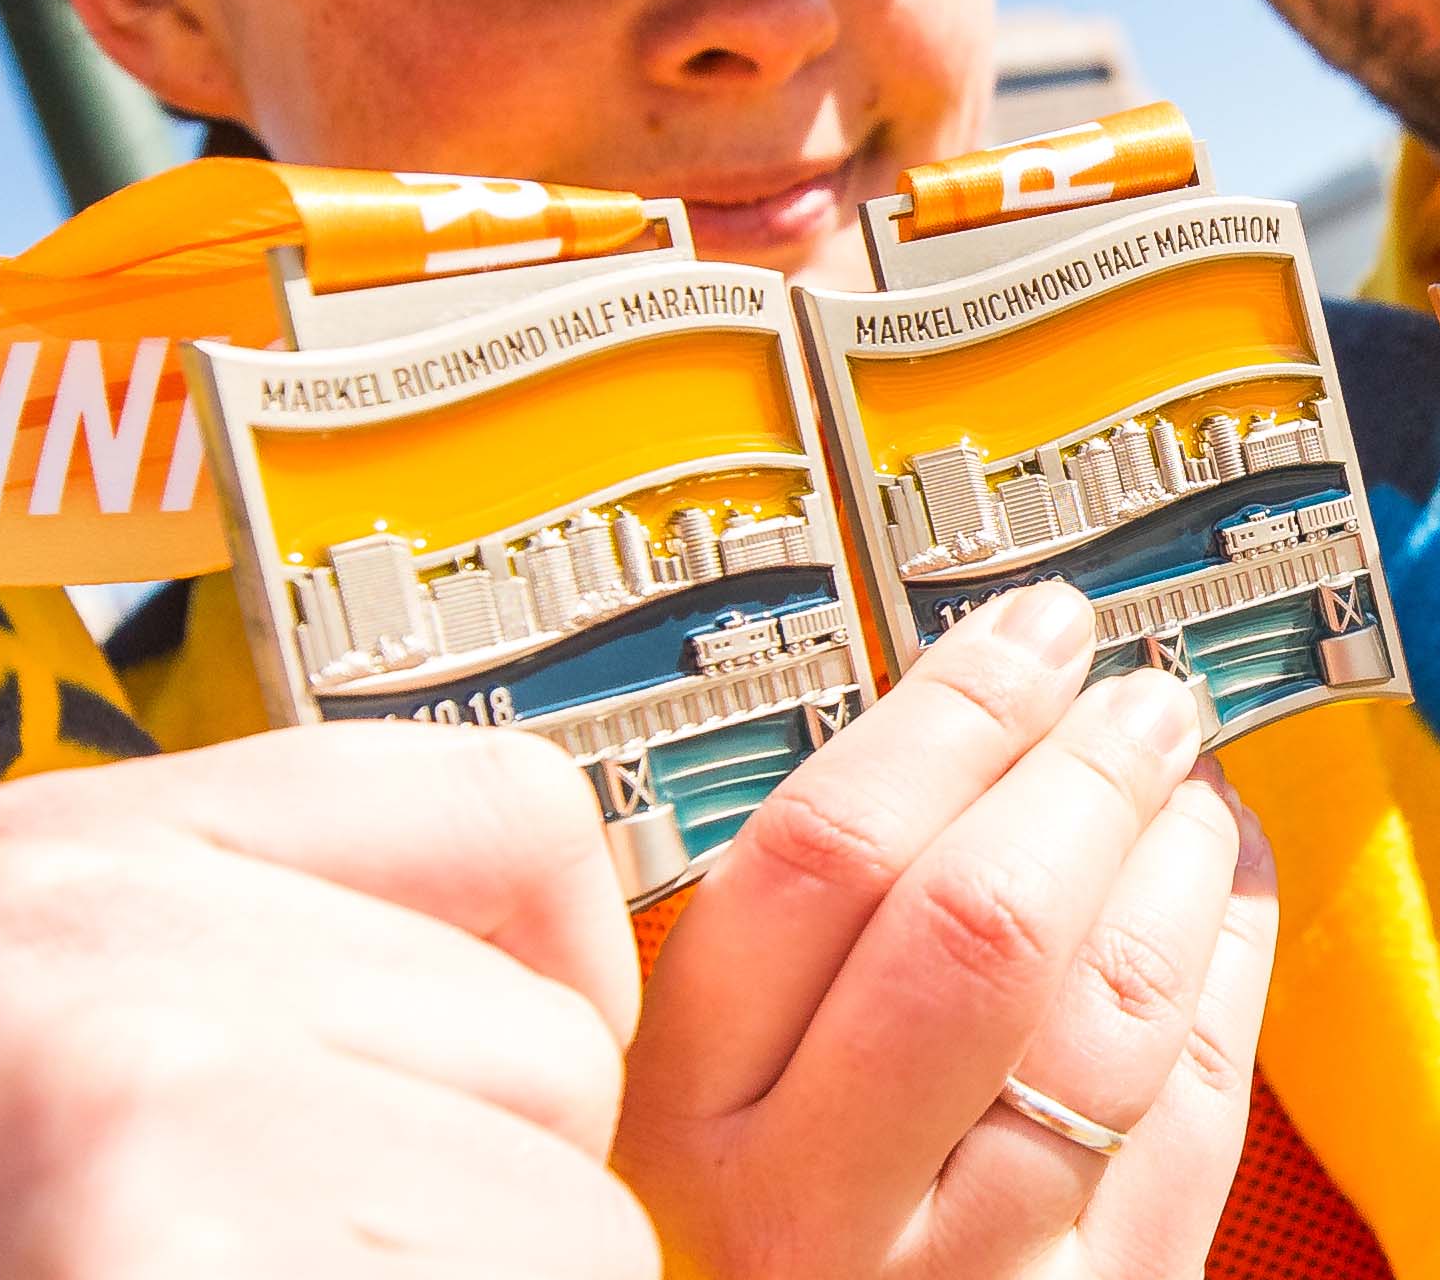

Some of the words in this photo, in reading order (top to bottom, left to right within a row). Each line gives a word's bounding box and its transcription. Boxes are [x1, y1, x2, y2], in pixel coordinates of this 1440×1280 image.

[855, 304, 964, 346] MARKEL
[964, 263, 1094, 332] RICHMOND
[1093, 236, 1153, 282] HALF
[1154, 216, 1282, 260] MARATHON
[260, 364, 392, 413] MARKEL
[395, 325, 550, 400] RICHMOND
[550, 299, 616, 351] HALF
[619, 285, 766, 326] MARATHON
